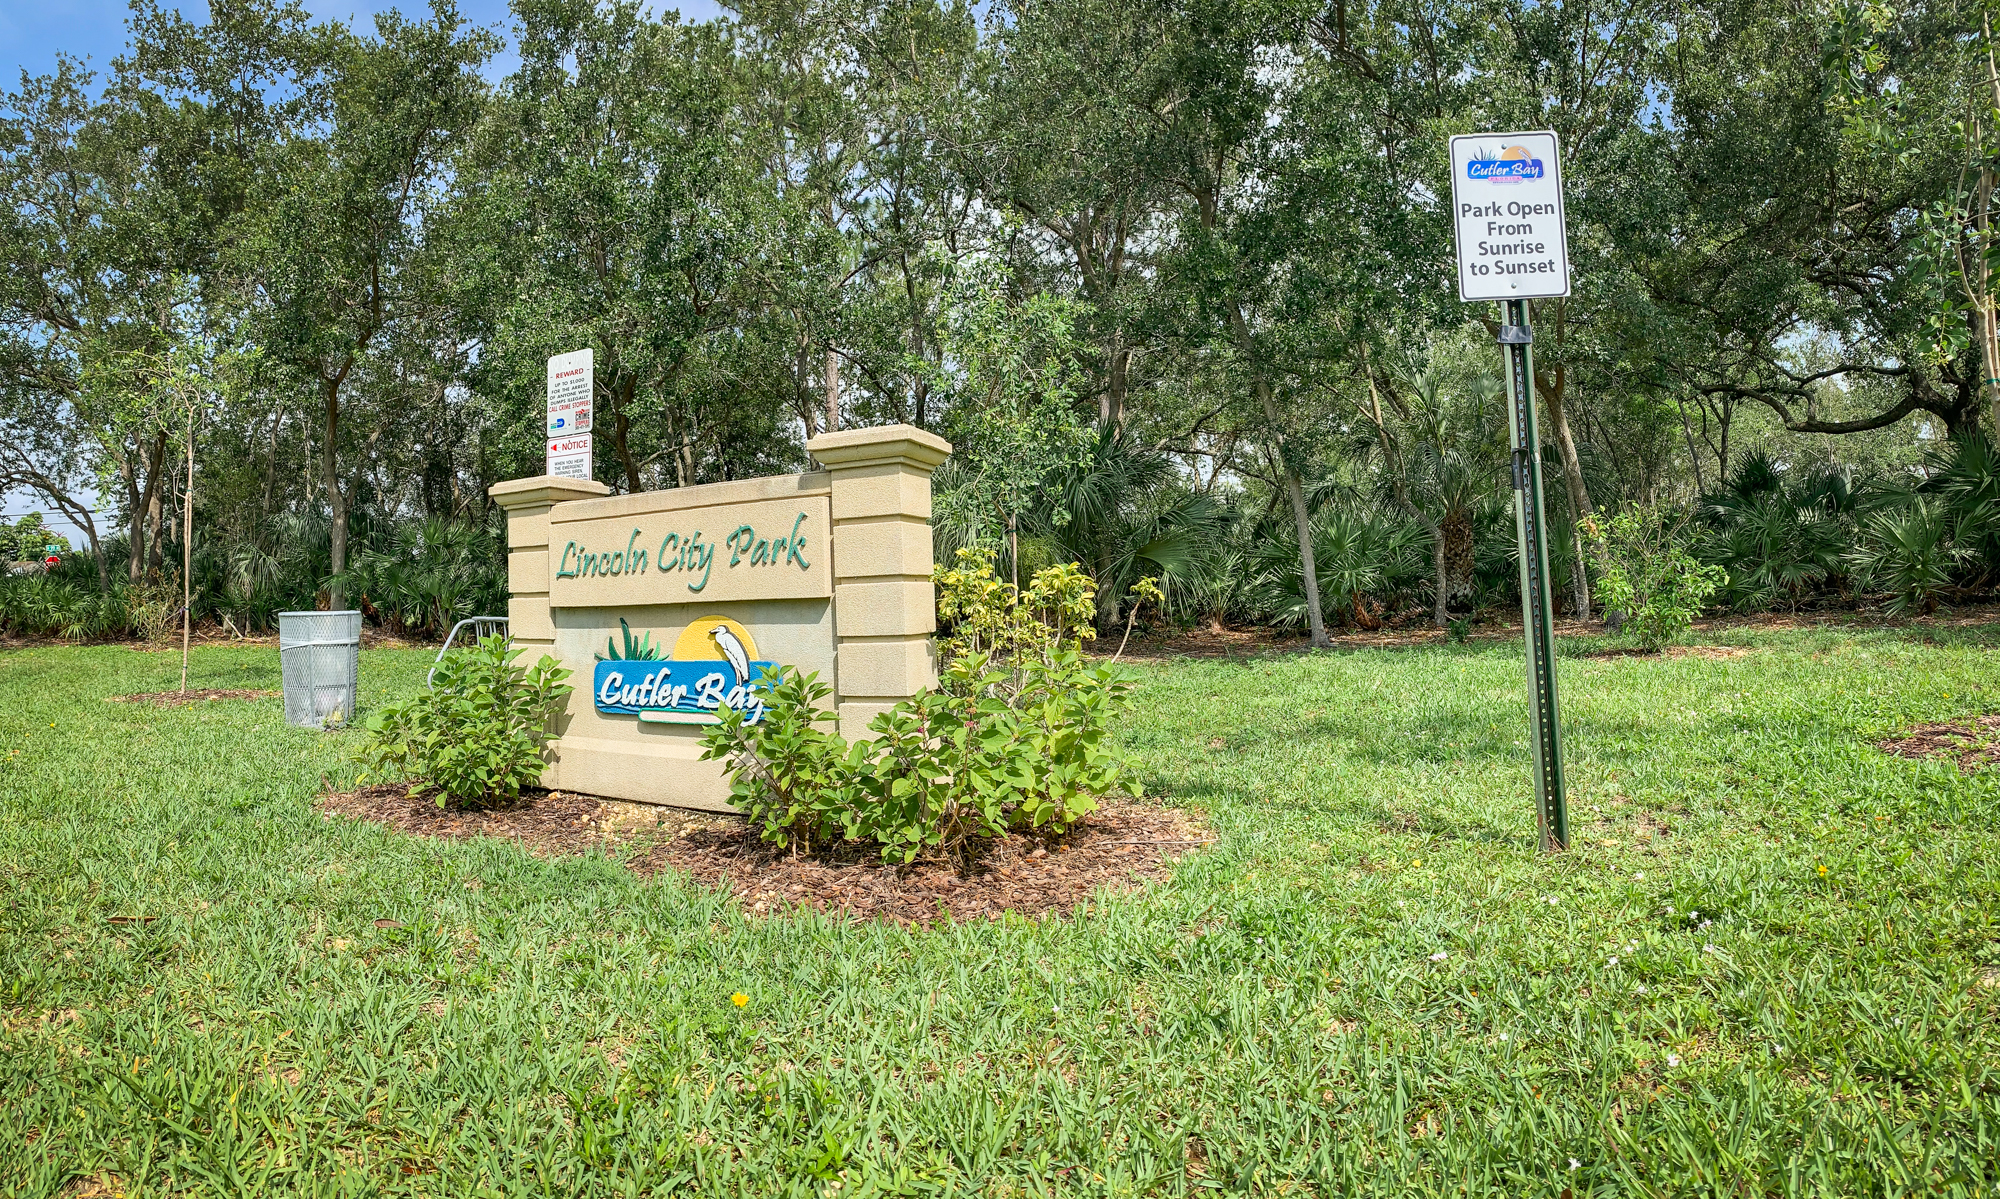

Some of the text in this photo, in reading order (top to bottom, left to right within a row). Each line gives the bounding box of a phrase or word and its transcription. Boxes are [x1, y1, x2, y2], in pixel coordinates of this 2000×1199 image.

[1471, 161, 1539, 180] Cutler Bay
[1461, 201, 1555, 219] Park Open
[1487, 221, 1533, 236] From
[1478, 239, 1545, 256] Sunrise
[1470, 259, 1555, 276] to Sunset
[555, 368, 584, 379] REWARD
[557, 391, 577, 399] ANYONE
[559, 403, 571, 411] CRIME
[572, 400, 591, 409] STOPPERS
[575, 411, 590, 421] CRIME
[562, 439, 588, 451] NOTICE
[556, 511, 811, 591] Lincoln City Park
[600, 667, 767, 728] Cutler Bay
